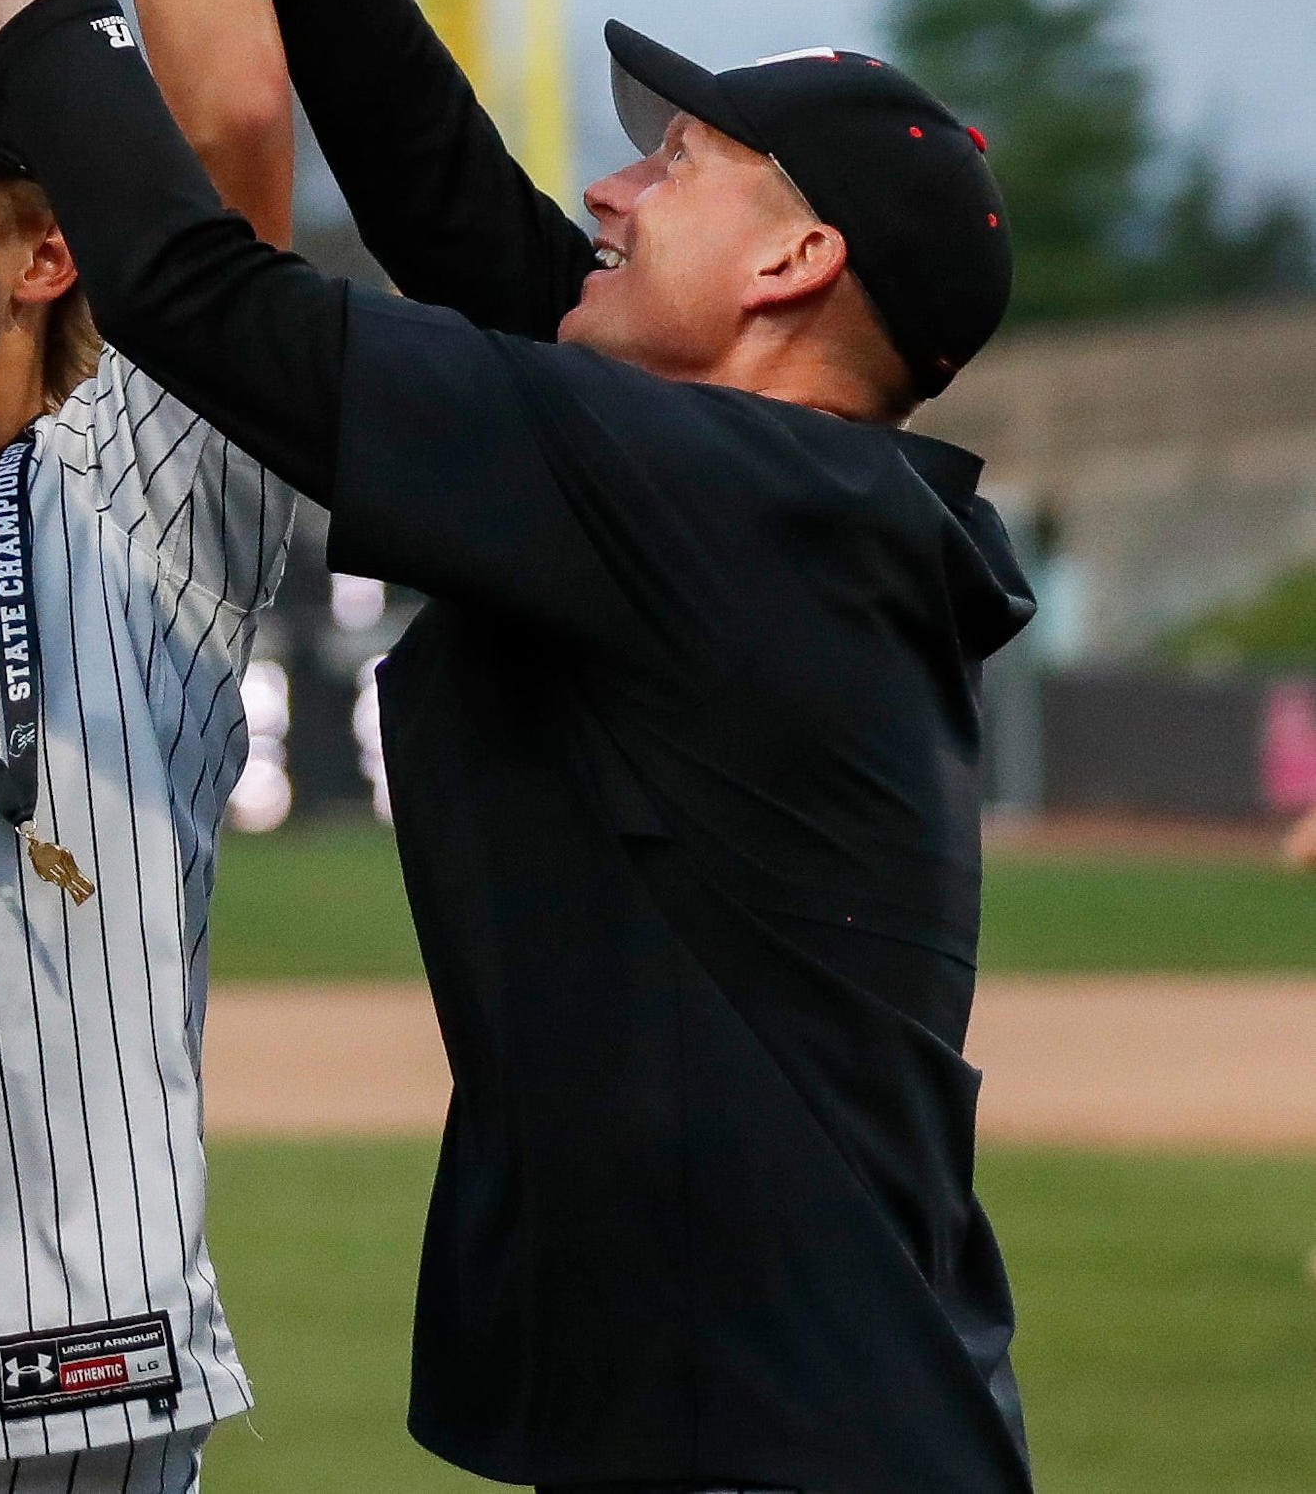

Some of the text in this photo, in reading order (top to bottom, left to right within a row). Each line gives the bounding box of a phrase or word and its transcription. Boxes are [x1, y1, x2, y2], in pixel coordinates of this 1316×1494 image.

[0, 603, 31, 703] STATE
[61, 1331, 160, 1355] UNDER ARMOUR
[64, 1362, 124, 1386] AUTHENTIC
[136, 1360, 160, 1373] LG
